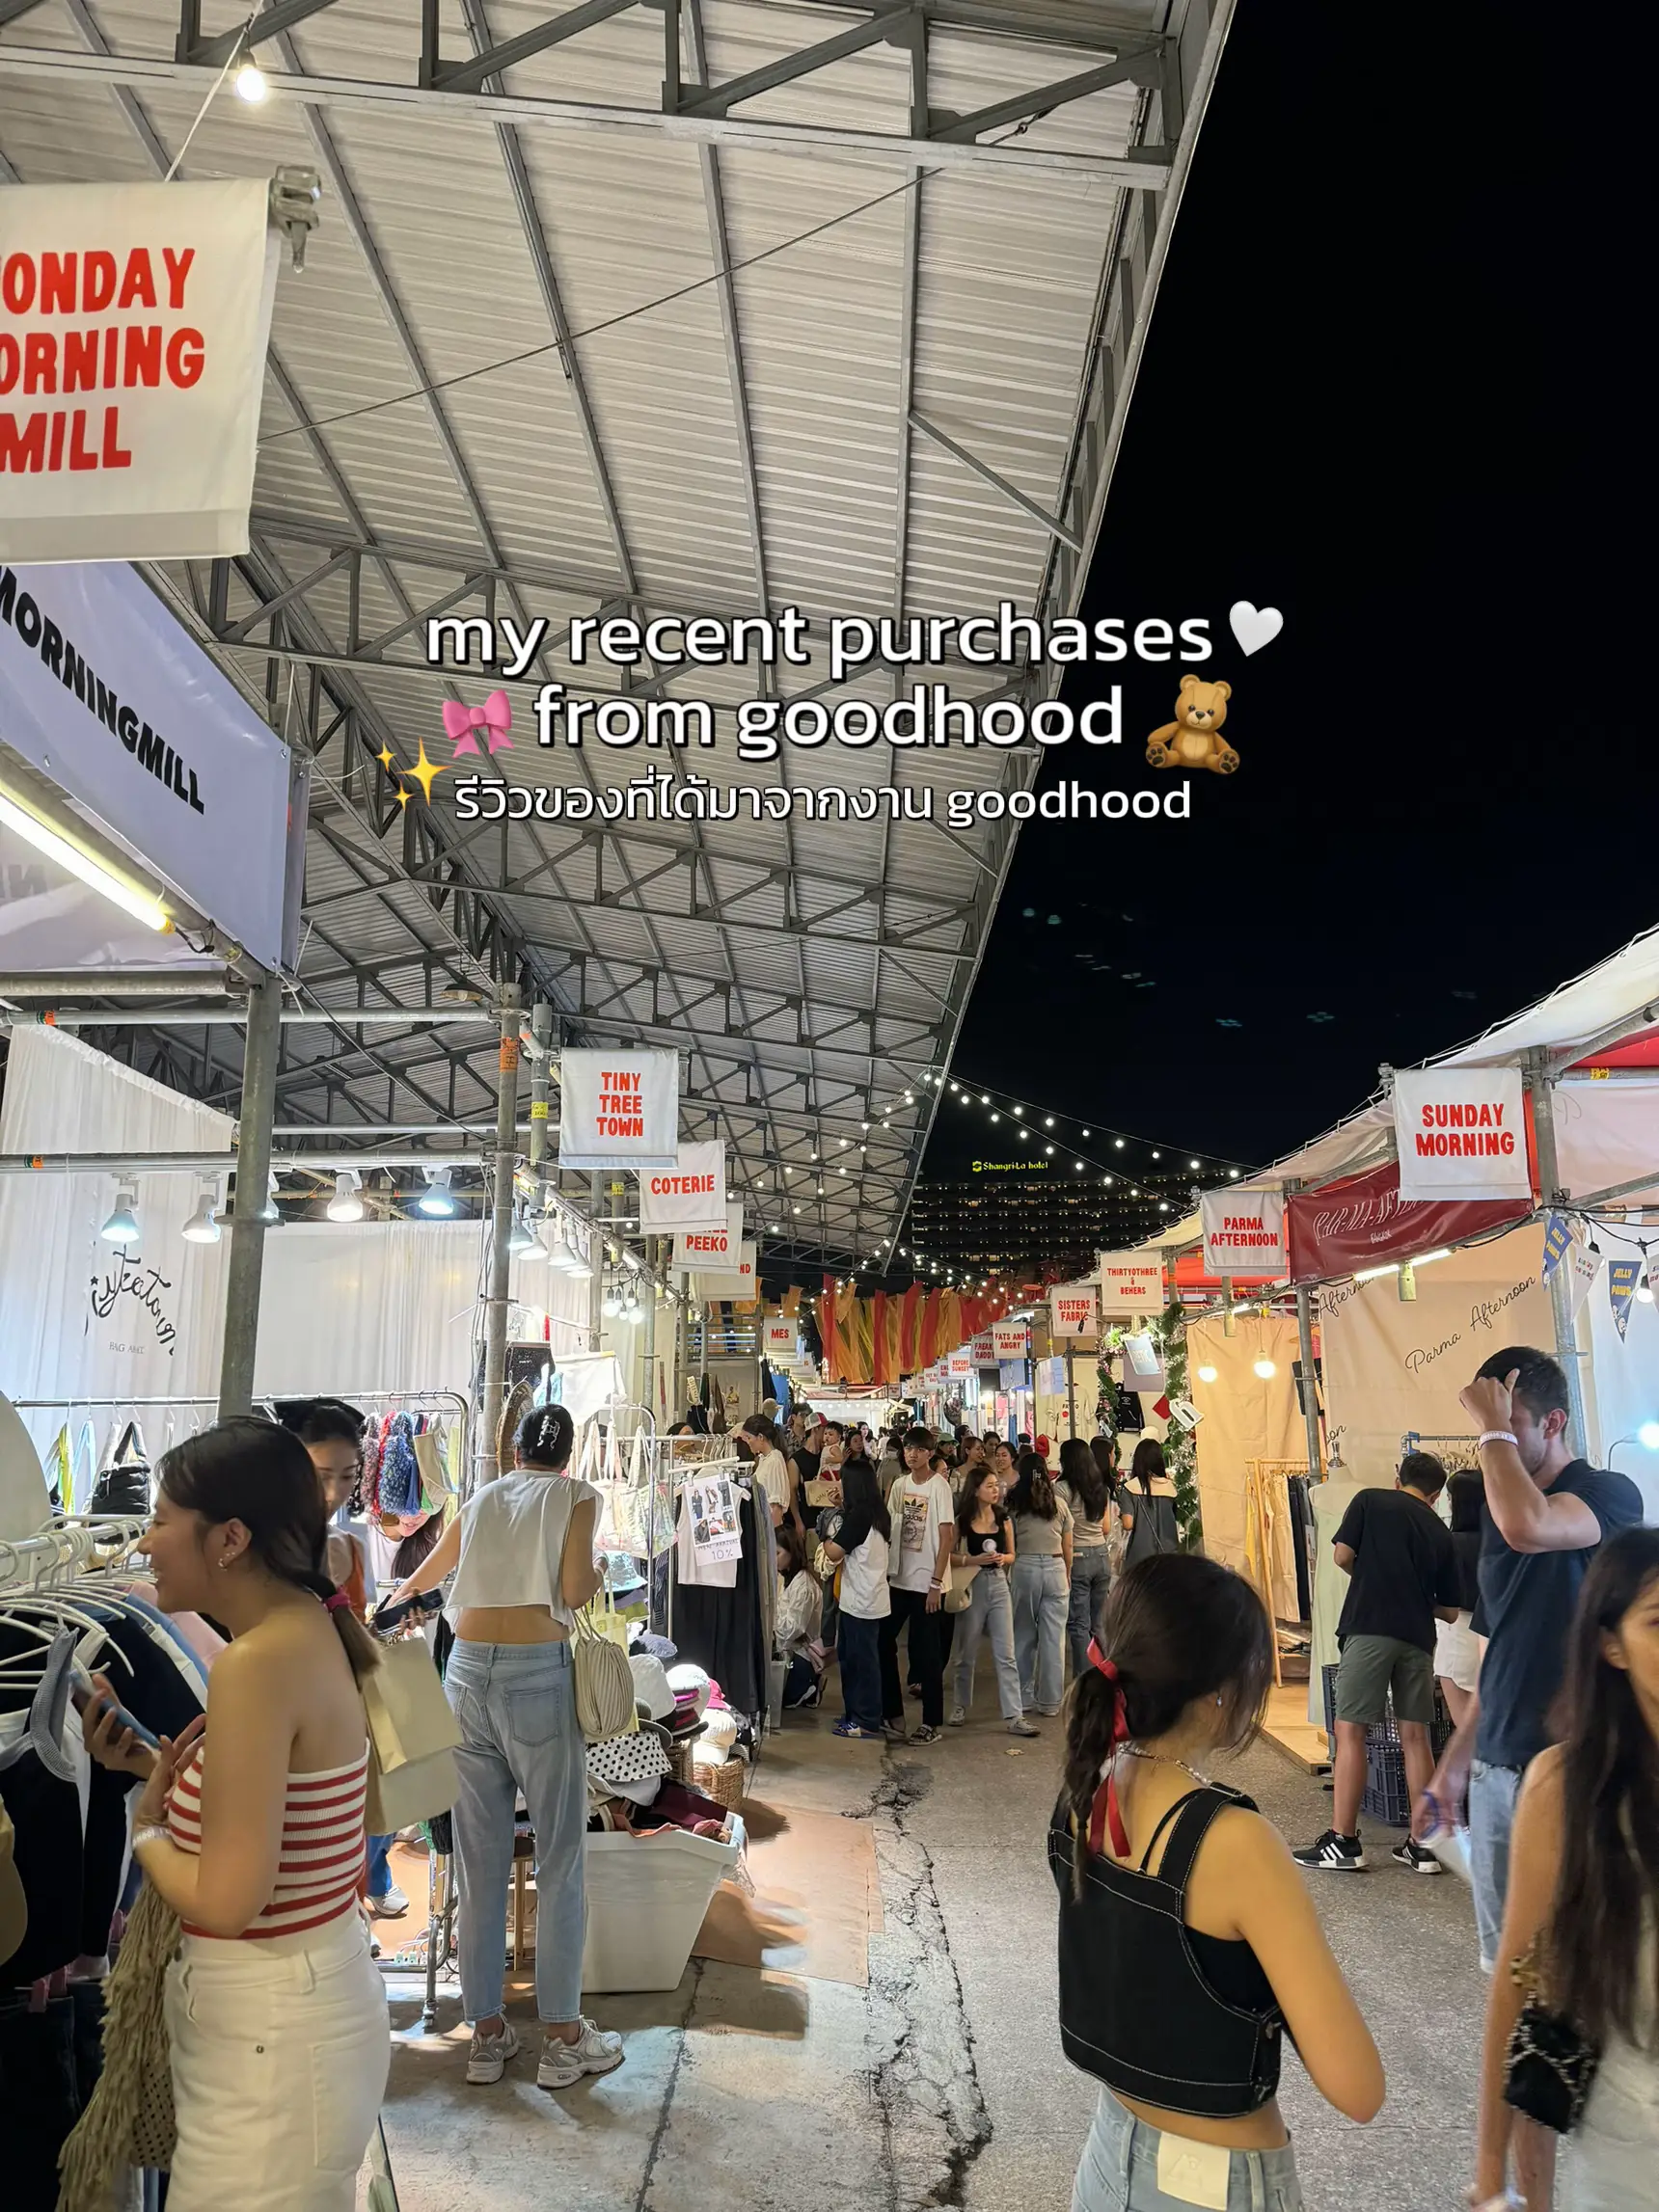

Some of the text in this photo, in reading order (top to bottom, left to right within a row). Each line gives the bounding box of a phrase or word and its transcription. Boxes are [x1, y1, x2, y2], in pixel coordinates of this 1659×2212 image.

[0, 247, 196, 315] ONDAY
[0, 406, 132, 473] MILL
[601, 1071, 641, 1093] TINY
[598, 1094, 642, 1115] TREE
[1421, 1103, 1505, 1128] SUNDAY
[596, 1117, 643, 1137] TOWN
[1415, 1131, 1515, 1158] MORNING
[650, 1173, 716, 1196] COTERIE
[1223, 1217, 1265, 1231] PARMA
[686, 1234, 728, 1253] PEEKO
[1210, 1232, 1279, 1248] AFTERNOON
[1057, 1299, 1091, 1310] SISTERS
[1060, 1310, 1089, 1322] FABRIC
[1404, 1276, 1537, 1373] Parma Afternoon
[771, 1329, 790, 1339] MES
[999, 1341, 1020, 1350] ANGRY
